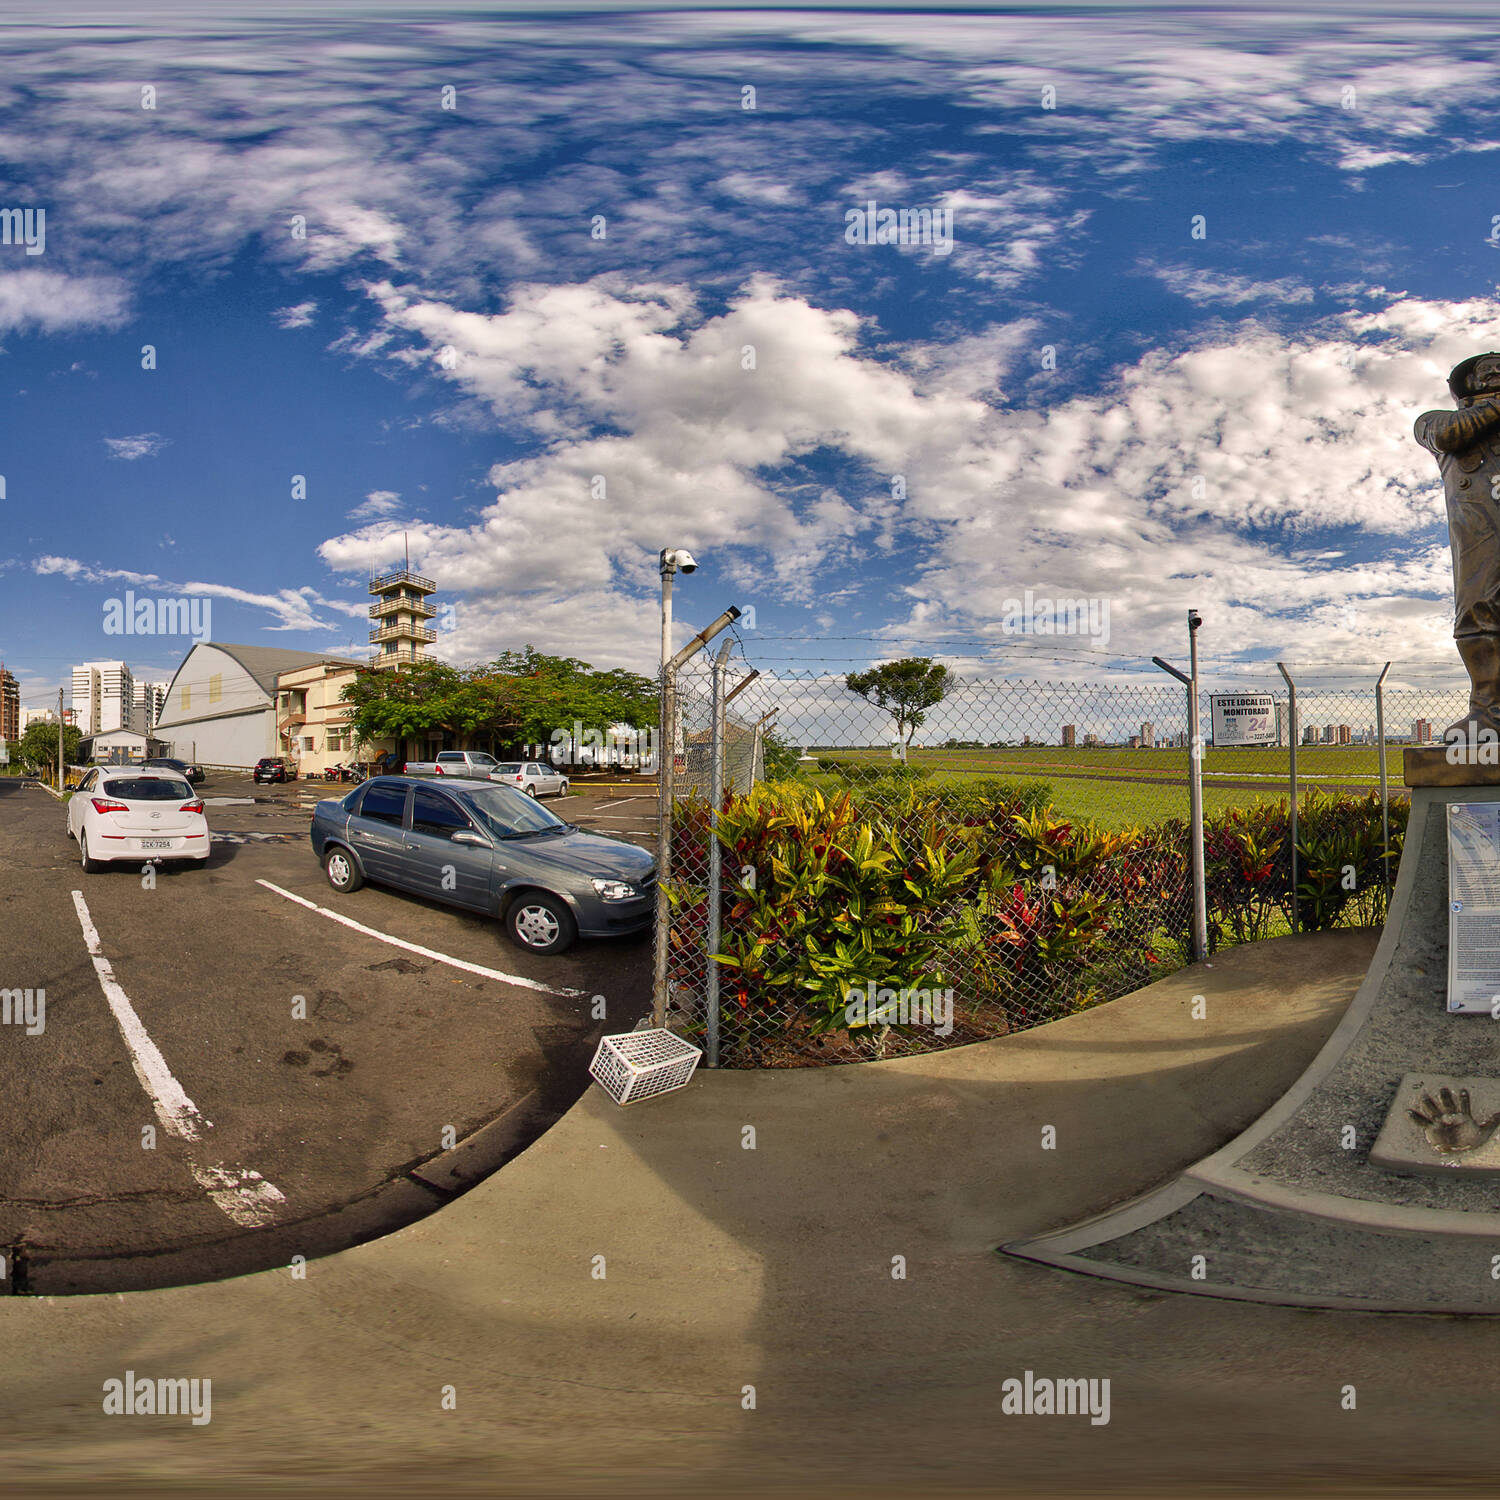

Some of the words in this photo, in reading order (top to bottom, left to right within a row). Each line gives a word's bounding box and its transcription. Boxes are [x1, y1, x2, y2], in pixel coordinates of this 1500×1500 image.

[1237, 698, 1258, 706] LOCAL
[1223, 707, 1269, 716] MONITORADO
[1248, 717, 1267, 731] 24
